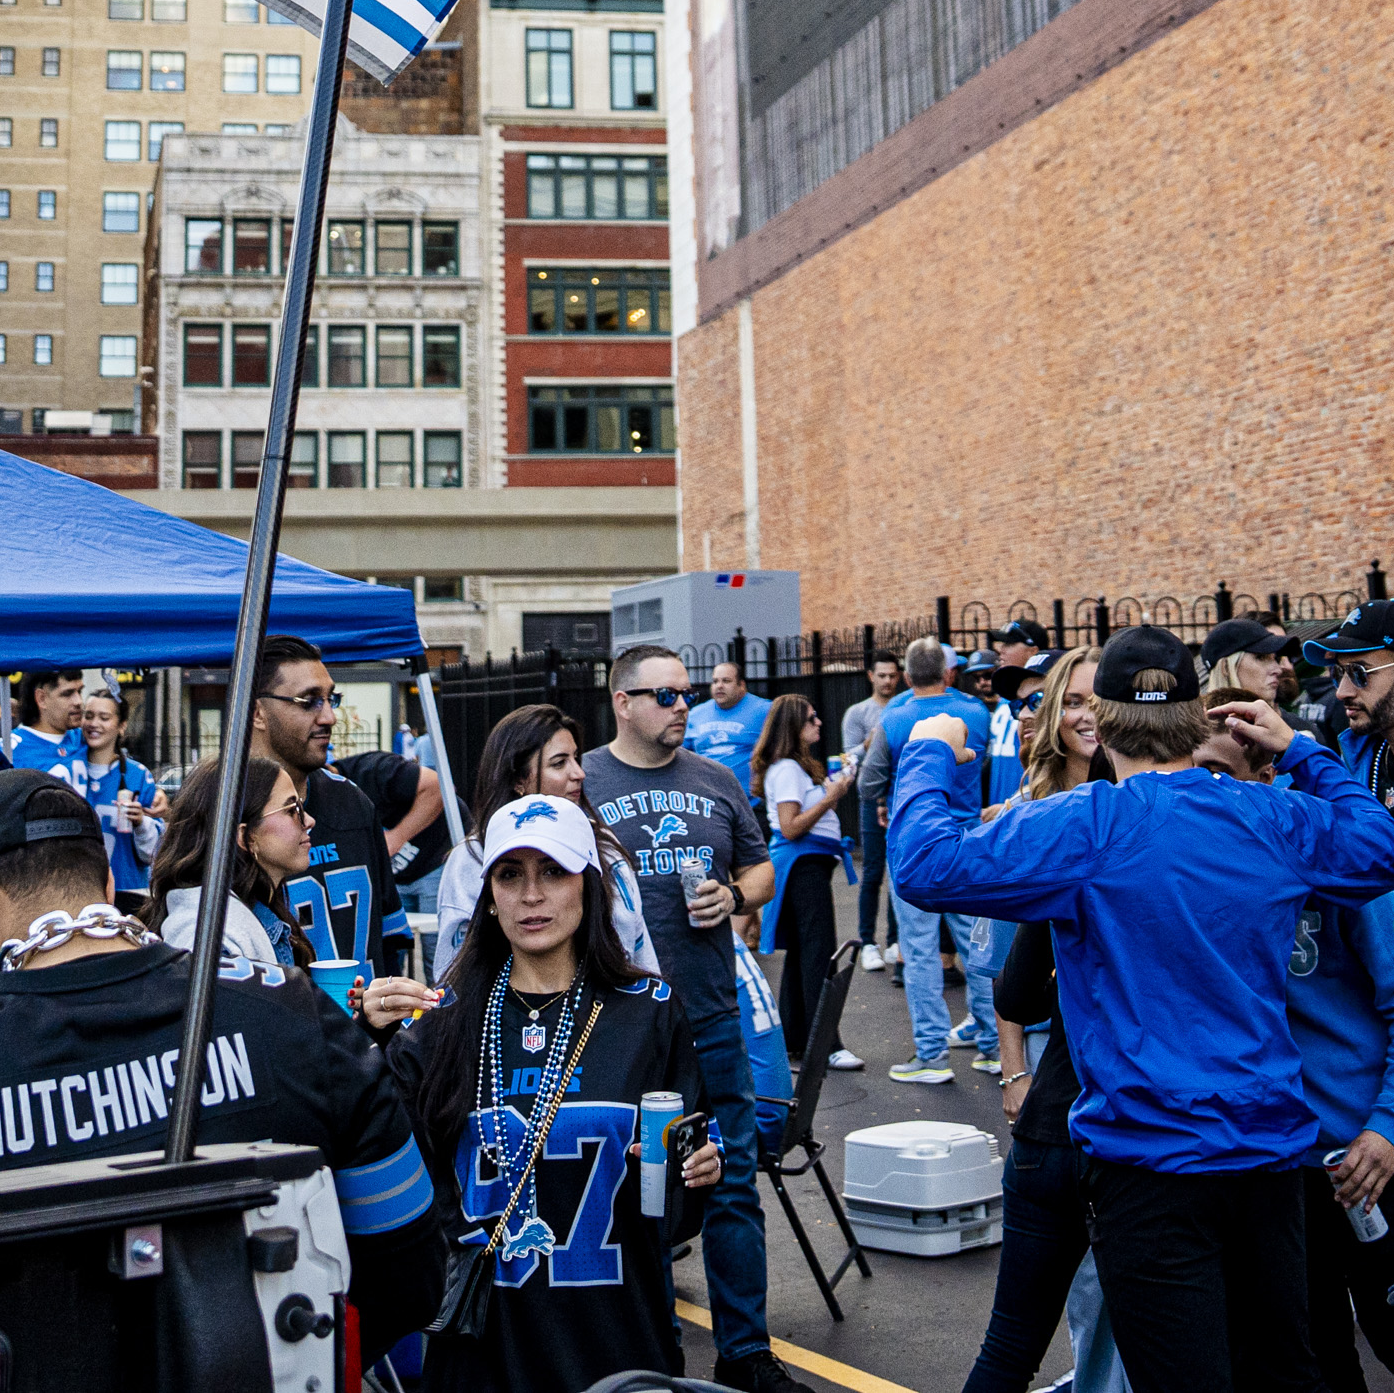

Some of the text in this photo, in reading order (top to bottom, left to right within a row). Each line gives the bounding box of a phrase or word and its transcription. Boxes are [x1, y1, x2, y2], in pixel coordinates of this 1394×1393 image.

[1135, 691, 1168, 702] LIONS
[598, 790, 716, 827] DETROIT
[636, 846, 714, 877] IONS
[526, 1035, 542, 1048] NFL
[454, 1101, 639, 1288] 97
